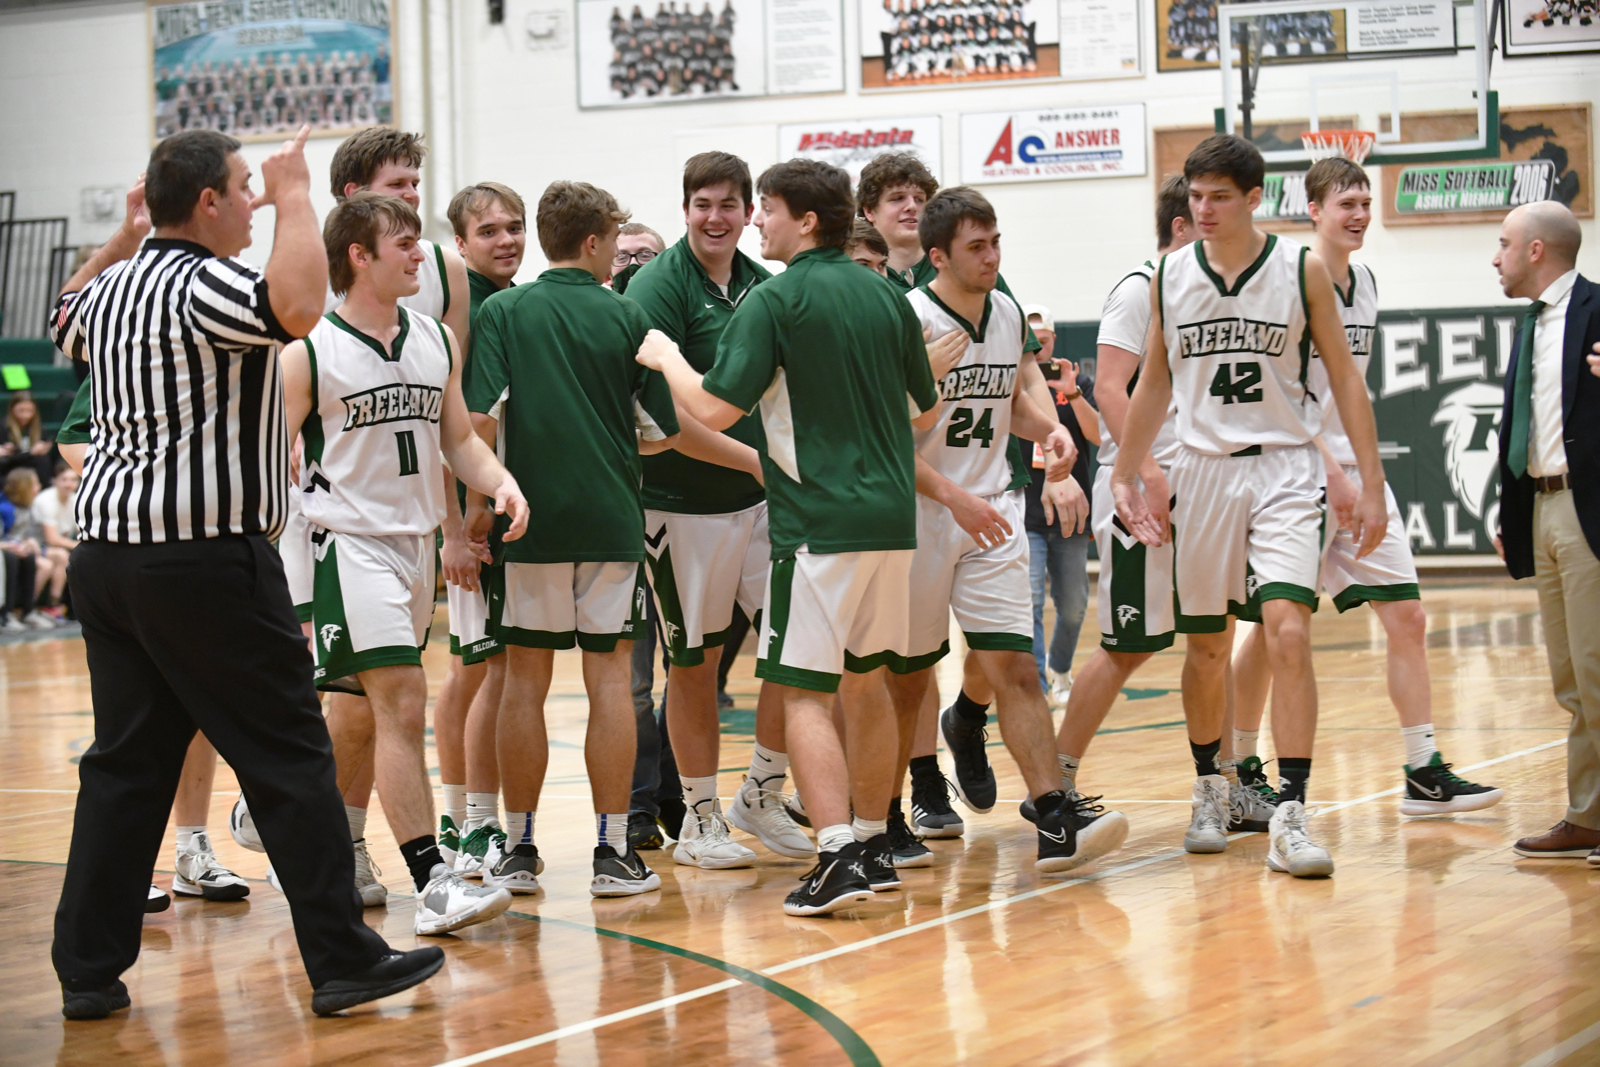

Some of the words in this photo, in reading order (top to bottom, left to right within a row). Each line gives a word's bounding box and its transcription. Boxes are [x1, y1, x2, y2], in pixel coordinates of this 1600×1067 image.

[1055, 128, 1120, 149] ANSWER
[982, 167, 1030, 178] HEATING
[1402, 172, 1440, 195] MISS
[1444, 168, 1510, 192] SOFTBALL
[1509, 164, 1550, 206] 2006
[1414, 193, 1458, 211] ASHLEY
[1459, 191, 1505, 208] NIEMAN
[1177, 318, 1288, 359] FREELAND
[1209, 362, 1264, 405] 42
[341, 382, 442, 432] FREELAND
[946, 407, 994, 448] 24
